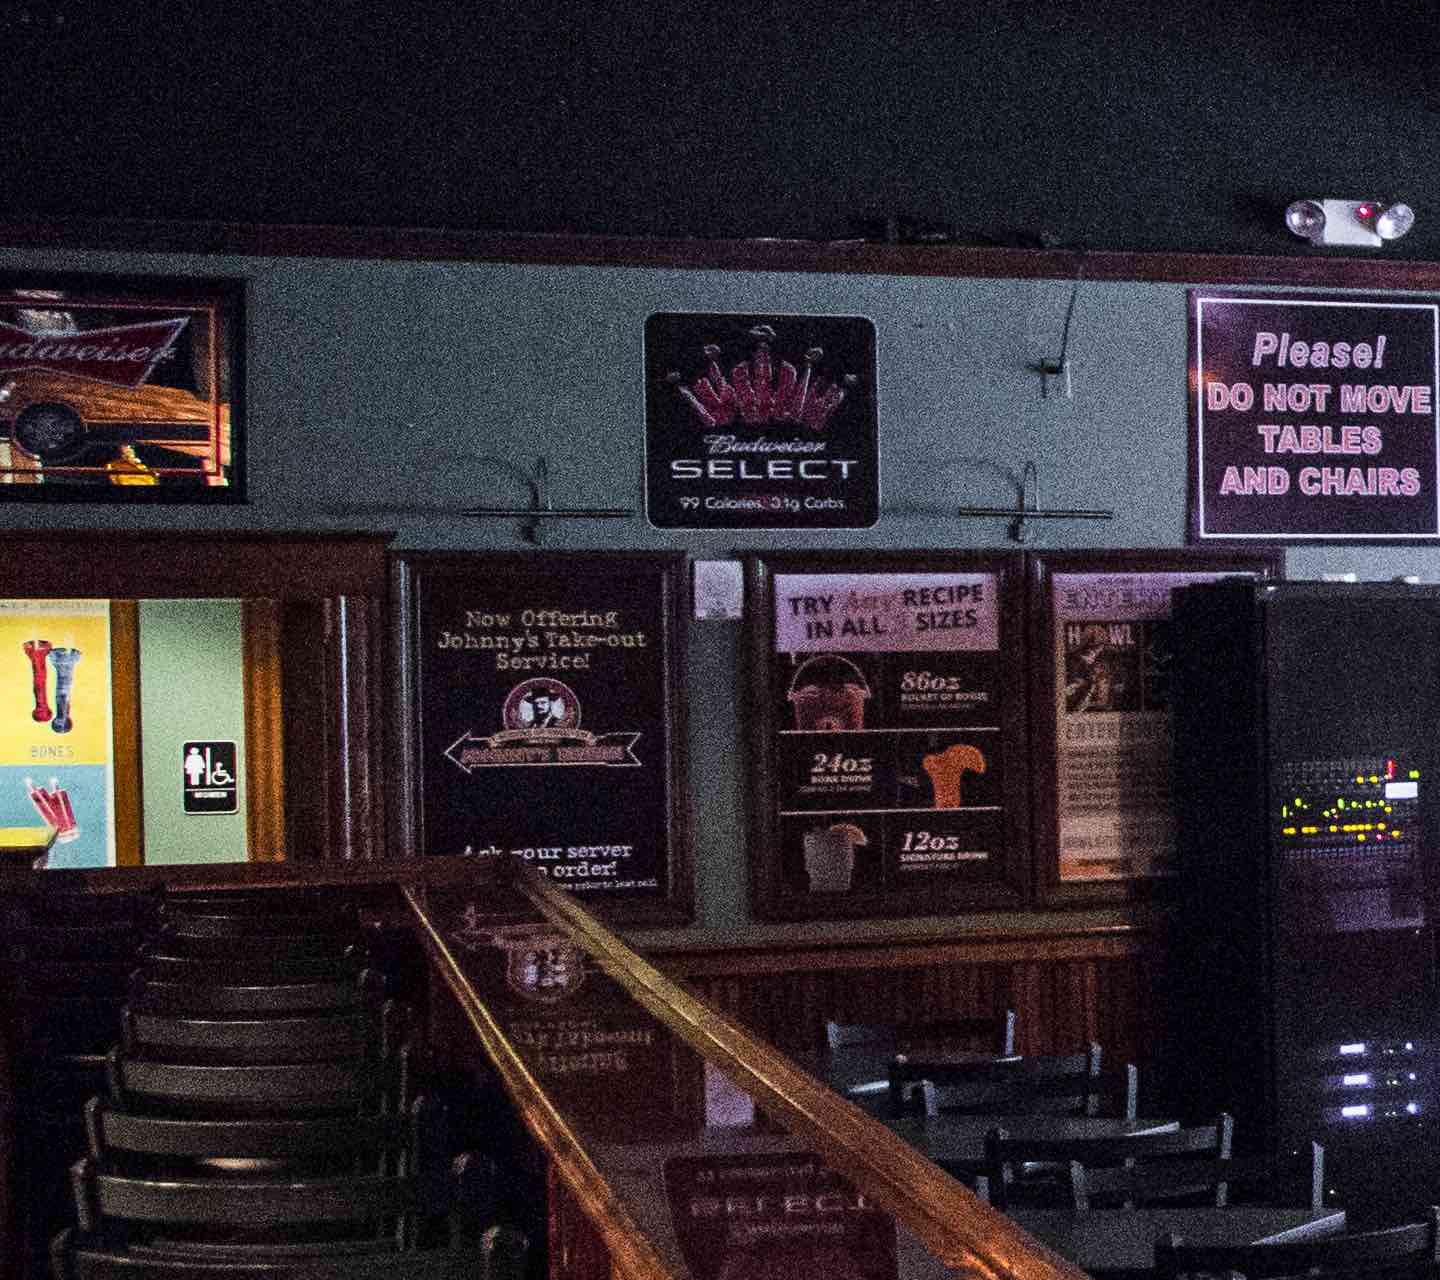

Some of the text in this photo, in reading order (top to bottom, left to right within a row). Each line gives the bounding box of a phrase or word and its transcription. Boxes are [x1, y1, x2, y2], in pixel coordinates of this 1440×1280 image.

[1252, 332, 1387, 369] Please!
[1207, 382, 1432, 414] DO NOT MOVE
[704, 434, 826, 454] Budweiser
[1258, 425, 1383, 455] TABLES
[671, 460, 859, 480] SELECT
[1219, 466, 1421, 496] AND CHAIRS
[789, 595, 834, 616] TRY
[903, 583, 984, 607] RECIPE
[466, 609, 619, 628] Now Offering
[806, 609, 978, 639] IN ALL SIZES
[438, 631, 647, 652] Johnny's Take-out
[496, 653, 590, 670] Service!
[31, 745, 73, 758] BONES
[810, 753, 873, 773] 24oz
[902, 831, 960, 851] 12oz
[511, 845, 561, 859] our
[567, 845, 632, 858] server
[553, 862, 617, 878] order!
